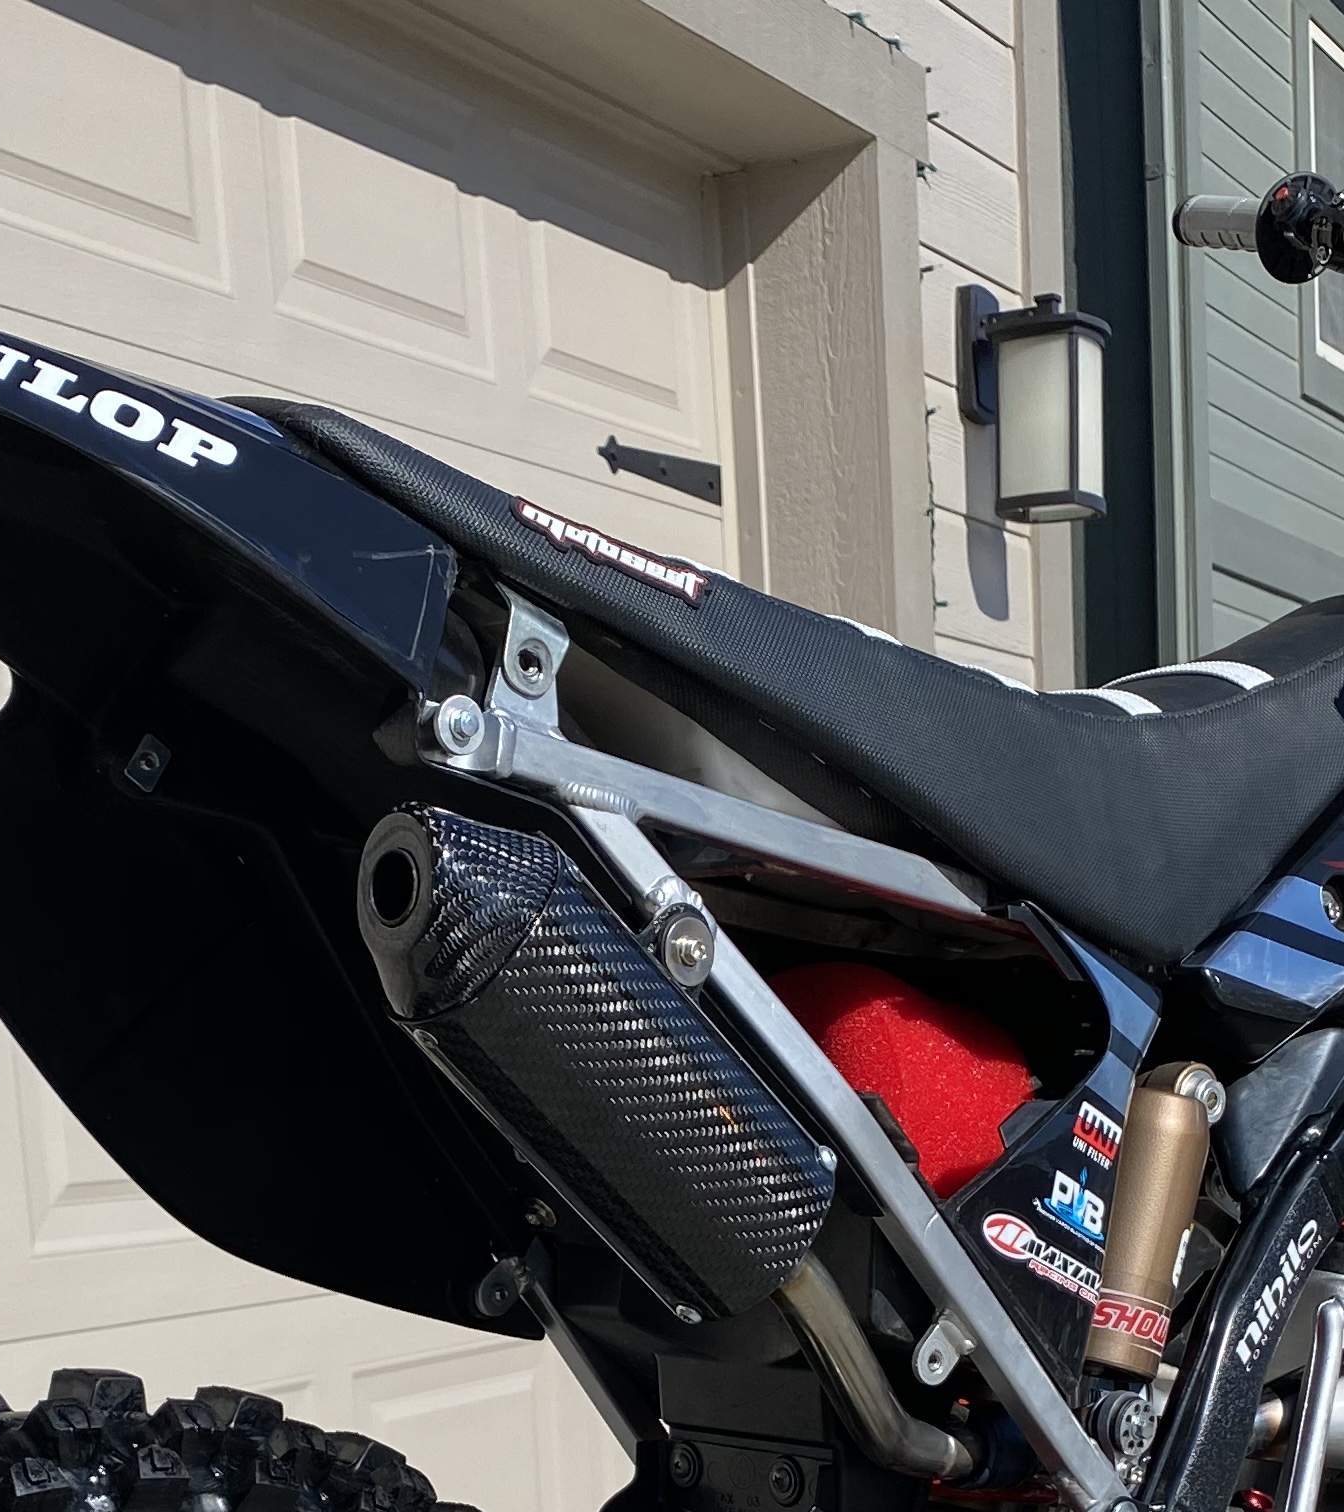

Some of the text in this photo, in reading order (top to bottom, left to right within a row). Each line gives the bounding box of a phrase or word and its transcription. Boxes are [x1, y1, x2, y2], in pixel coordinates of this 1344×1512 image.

[1072, 1135, 1112, 1170] UNI FILTER
[1029, 1259, 1078, 1293] RACING
[1235, 1219, 1318, 1365] nihilo
